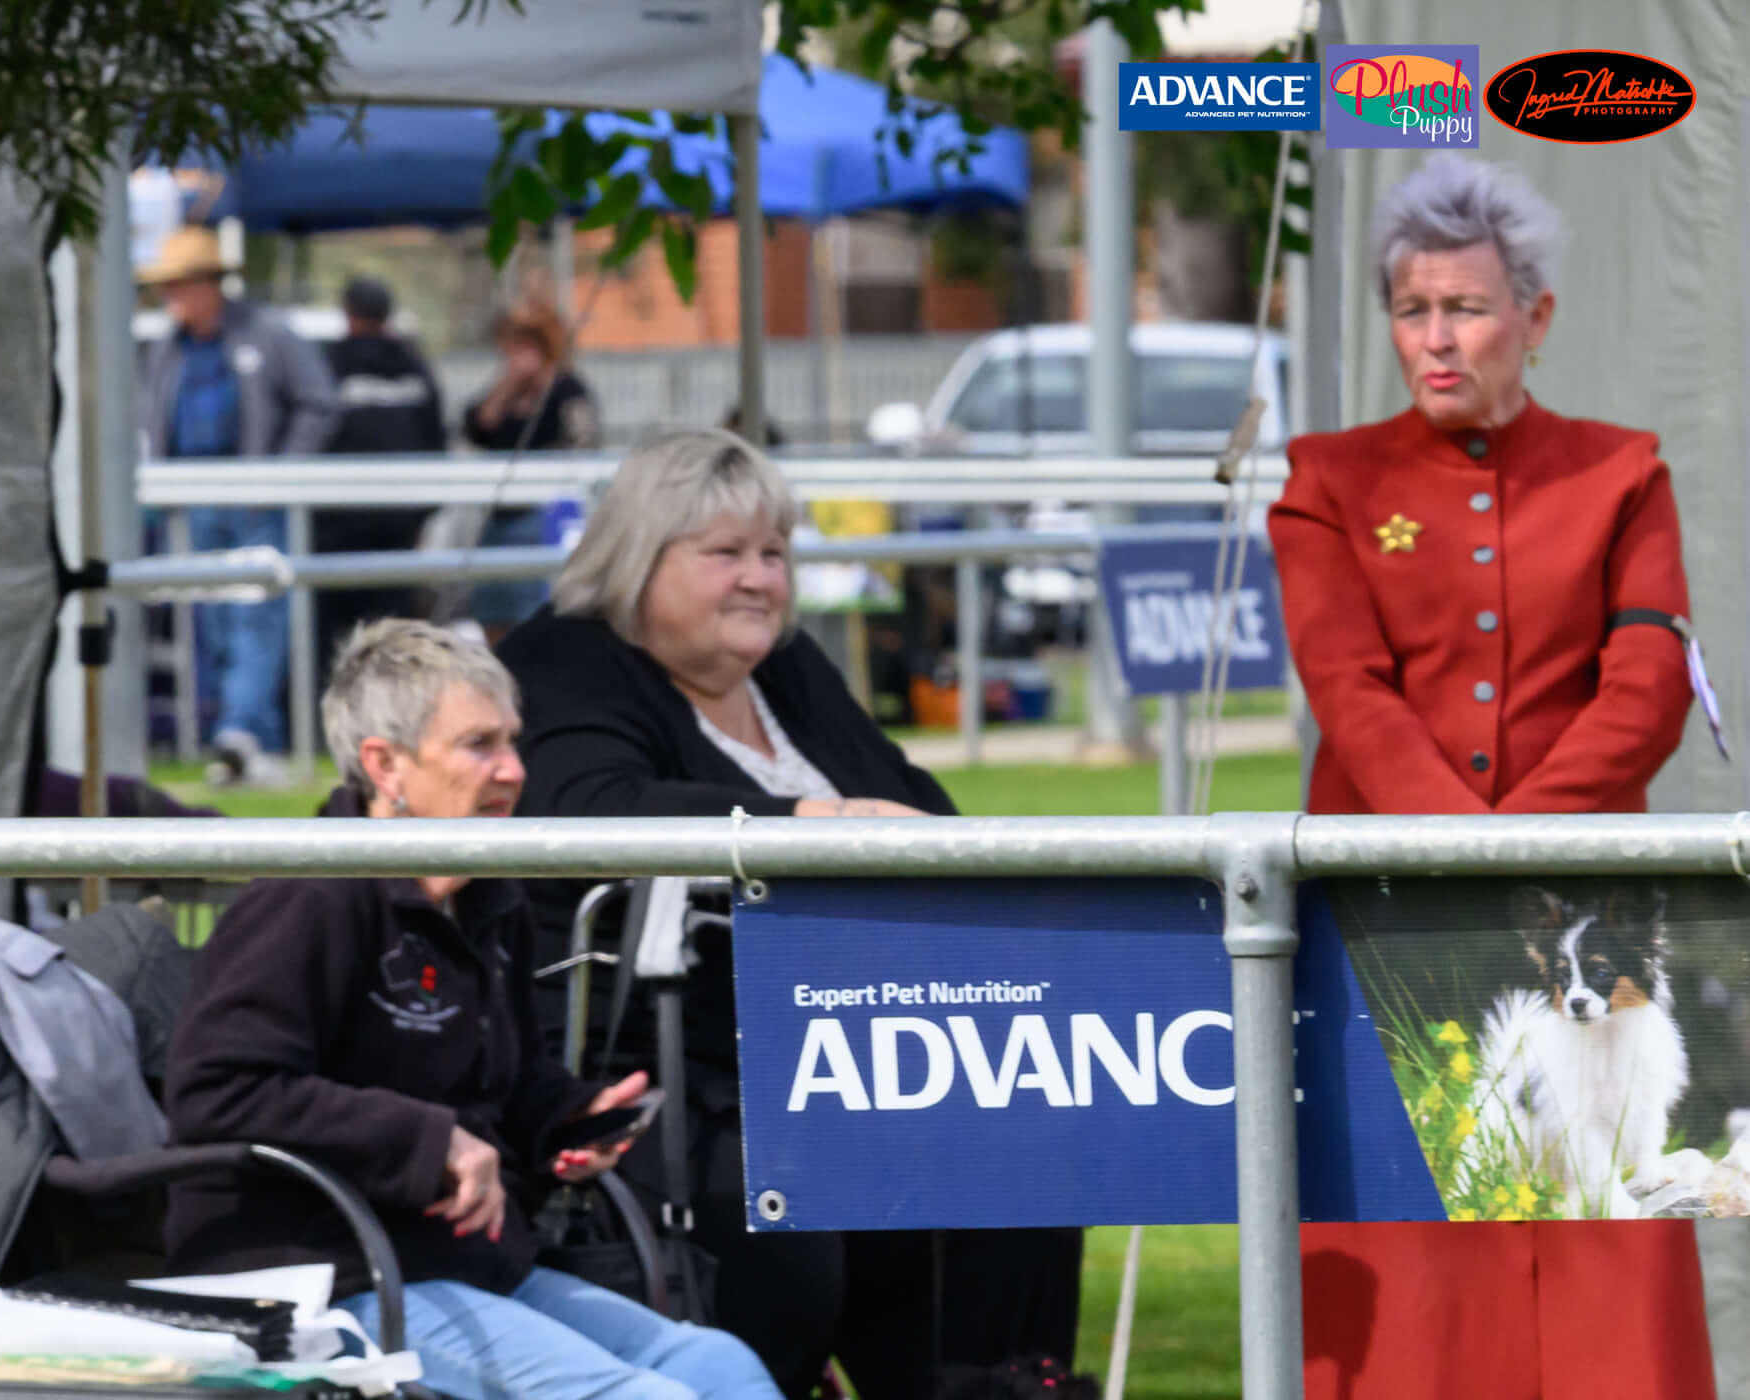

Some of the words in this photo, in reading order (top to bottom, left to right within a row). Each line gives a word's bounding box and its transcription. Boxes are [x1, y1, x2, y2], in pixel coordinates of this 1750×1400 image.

[793, 983, 877, 1011] Expert
[881, 982, 925, 1005] Pet
[786, 1009, 1305, 1112] ADVANC
